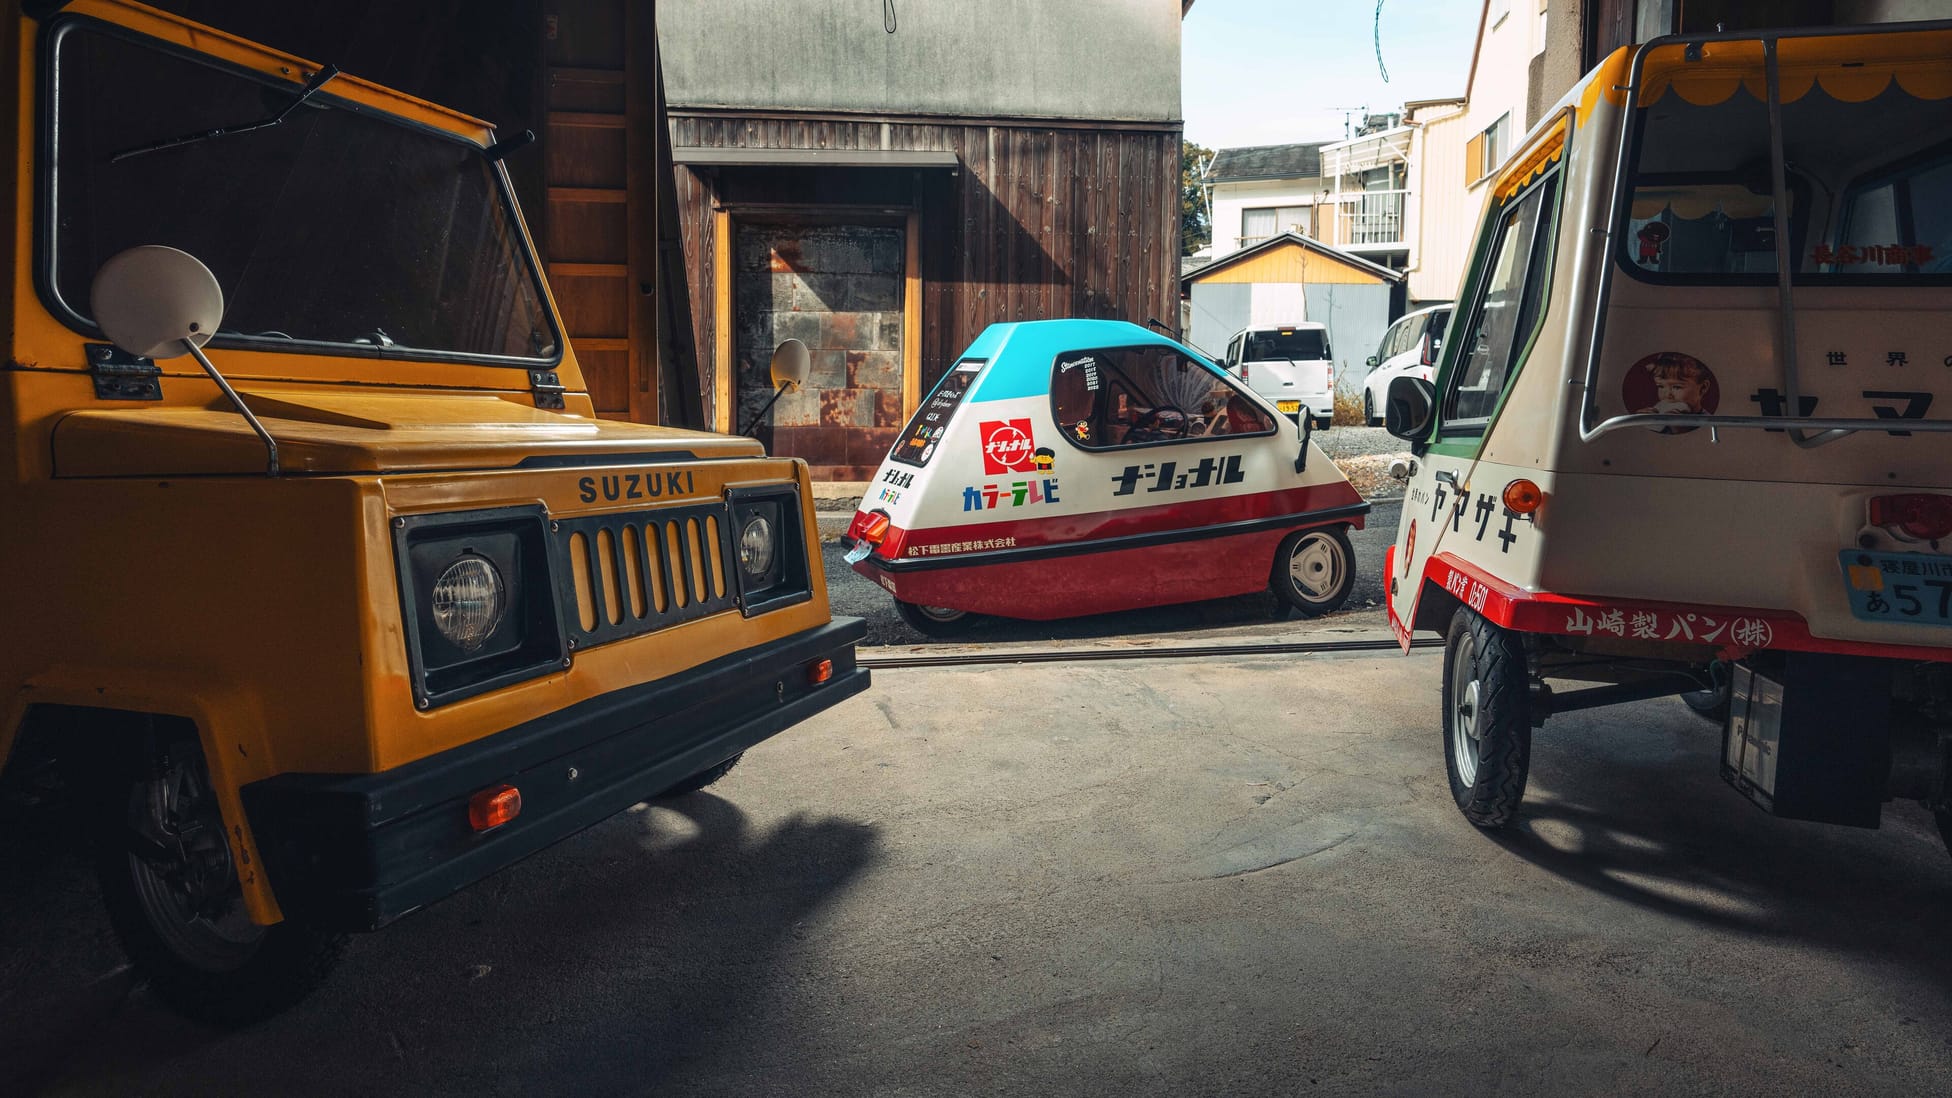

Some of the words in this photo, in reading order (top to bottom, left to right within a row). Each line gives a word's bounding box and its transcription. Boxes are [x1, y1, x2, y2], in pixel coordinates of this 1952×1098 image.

[985, 437, 1032, 454] ナショナル
[579, 471, 695, 503] SUZUKI
[882, 469, 914, 489] ナショナル
[1111, 455, 1245, 496] ナショナル
[963, 478, 1060, 511] カラーテレビ
[1432, 483, 1520, 553] ヤマザキ
